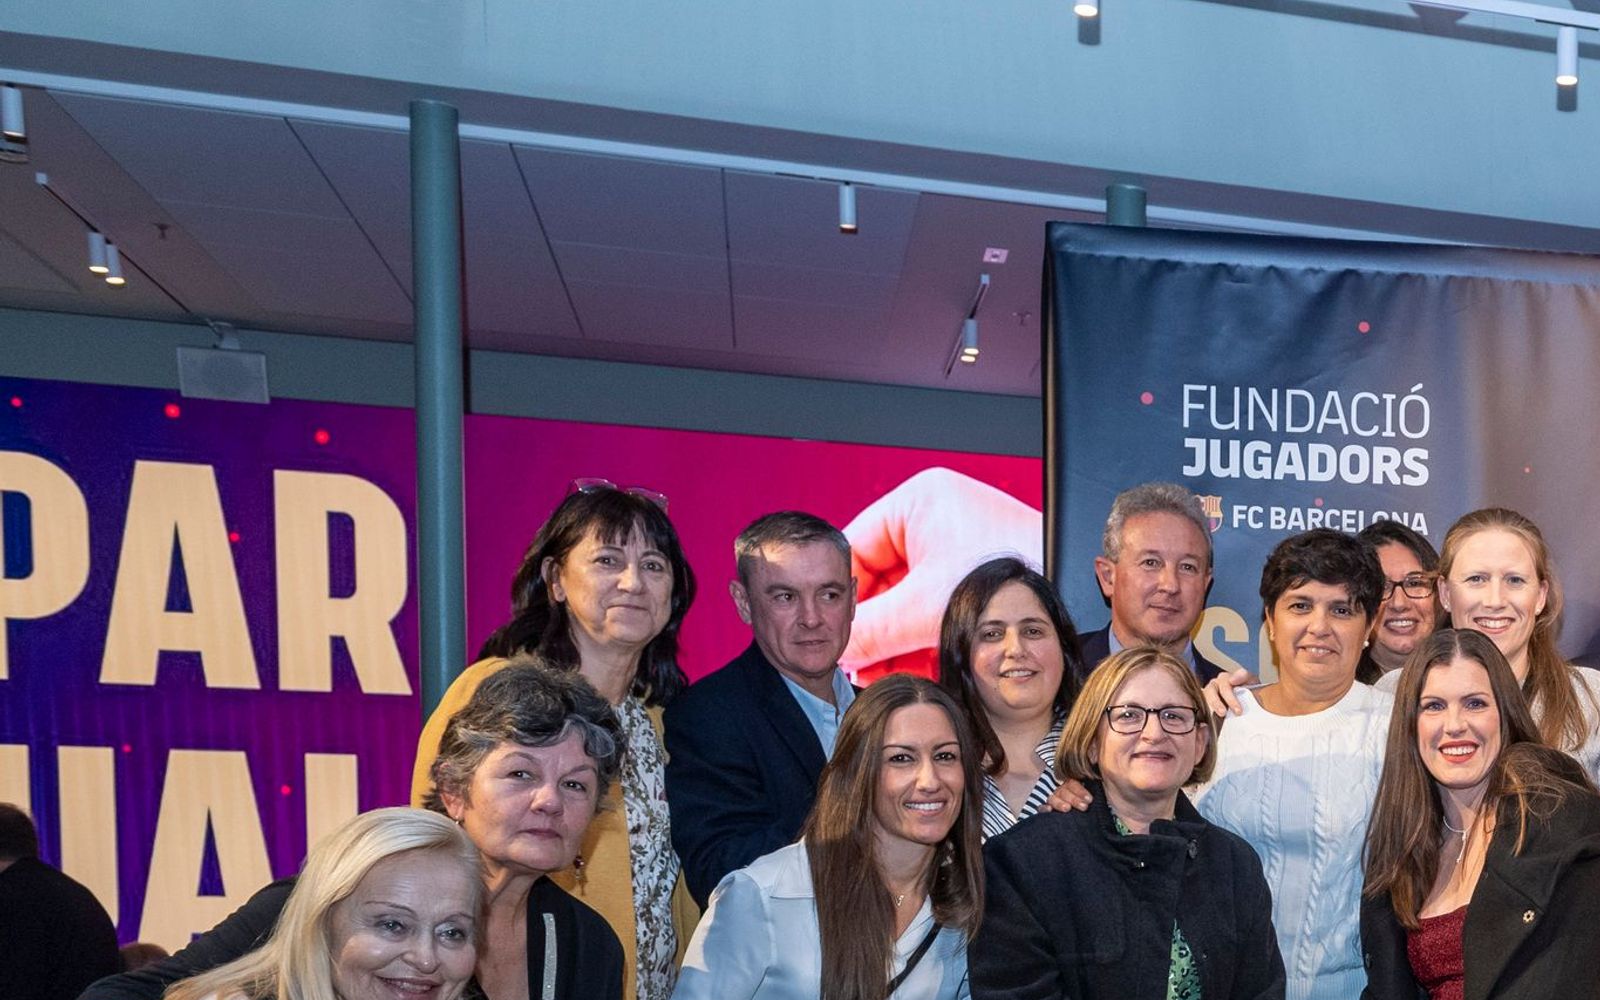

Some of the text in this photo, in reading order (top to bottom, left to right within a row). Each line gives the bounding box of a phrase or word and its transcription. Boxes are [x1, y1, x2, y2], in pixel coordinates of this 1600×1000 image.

[1182, 383, 1431, 439] FUNDACIÓ
[1182, 437, 1430, 487] JUGADORS
[1232, 505, 1264, 529] FC
